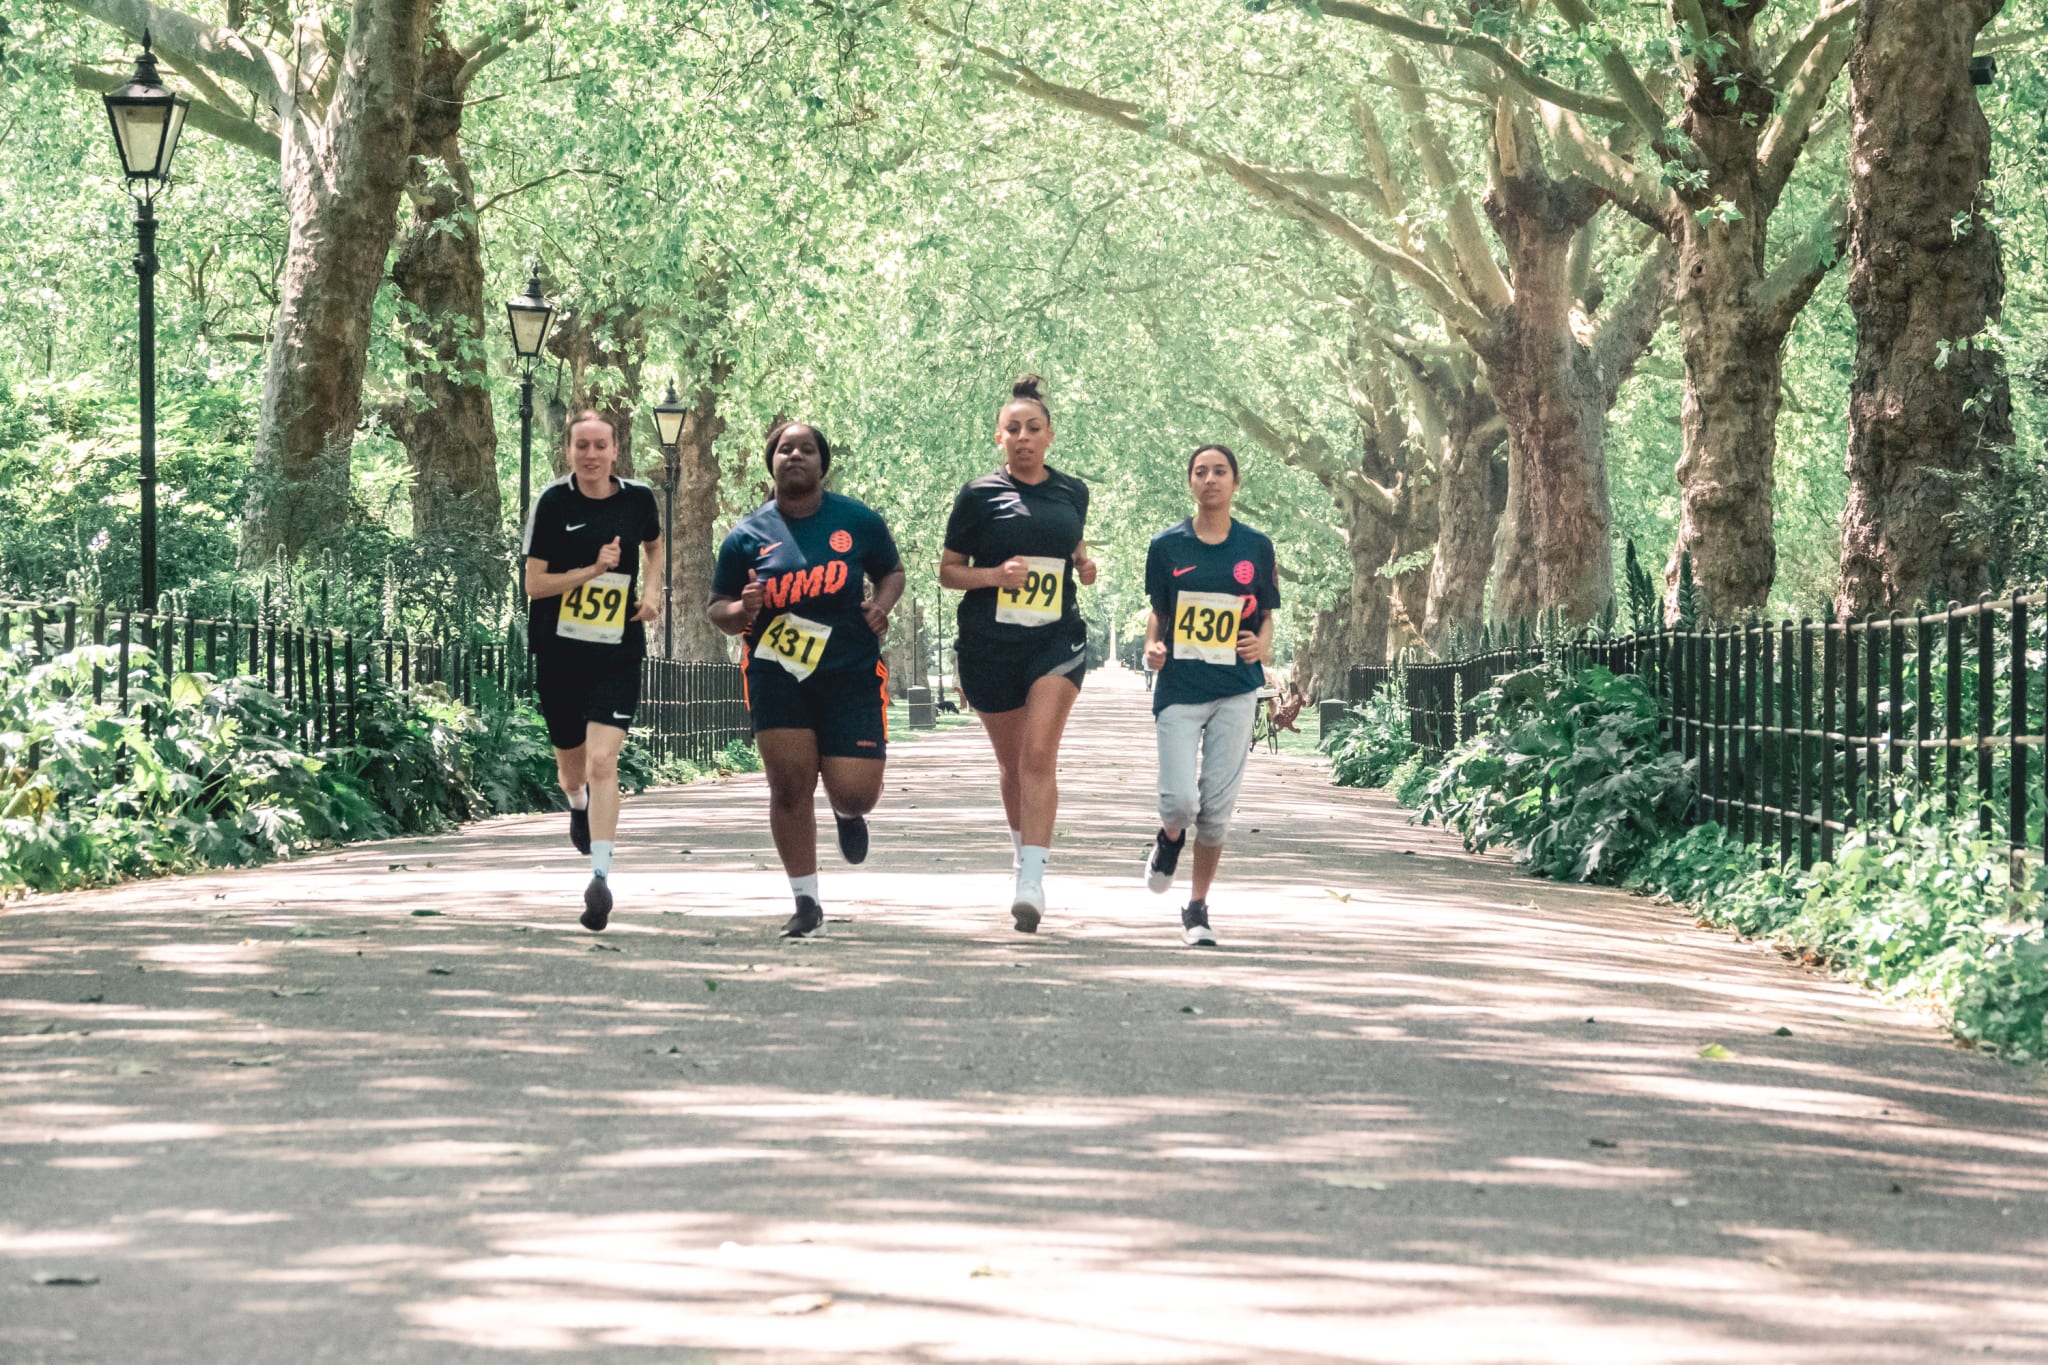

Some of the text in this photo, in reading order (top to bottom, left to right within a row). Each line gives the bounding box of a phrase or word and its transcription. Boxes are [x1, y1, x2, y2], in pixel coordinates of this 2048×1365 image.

[565, 585, 622, 622] 459
[764, 560, 848, 608] NMD
[768, 621, 816, 664] 431
[1178, 606, 1234, 643] 430
